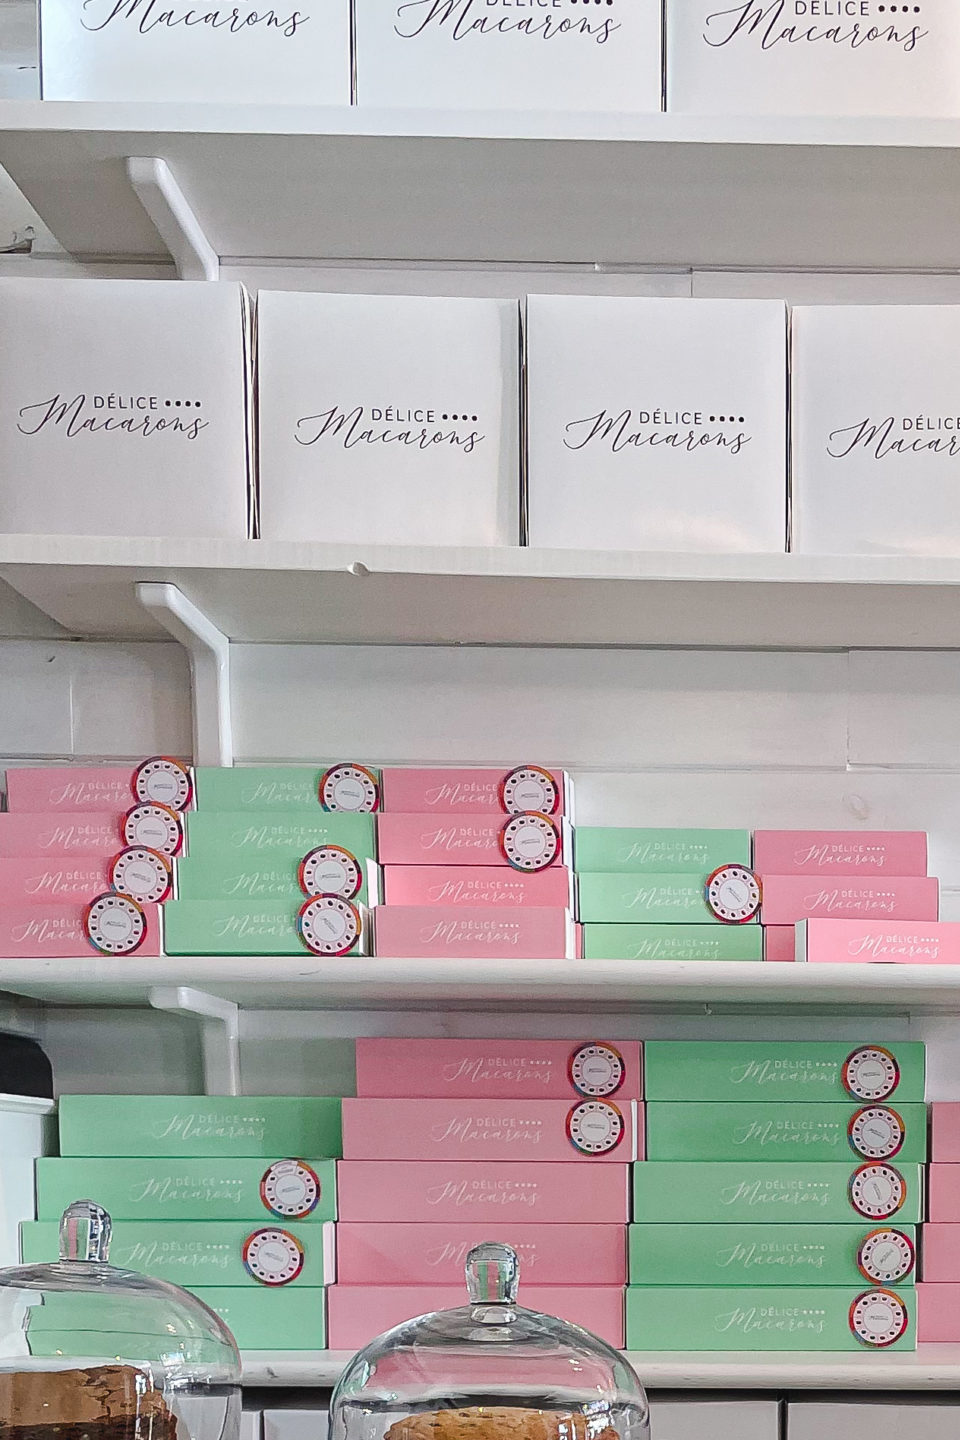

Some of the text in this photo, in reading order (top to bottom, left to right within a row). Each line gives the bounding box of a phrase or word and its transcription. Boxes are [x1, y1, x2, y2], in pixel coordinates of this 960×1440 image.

[80, 0, 310, 37] Macarons
[394, 0, 621, 44] Macarons
[703, 0, 928, 51] Macarons
[94, 393, 157, 409] DÉLICE
[17, 393, 209, 439] Macarons
[372, 405, 435, 422] DÉLICE
[640, 408, 702, 425] DÉLICE
[295, 405, 485, 453] Macarons
[563, 408, 752, 454] Macarons
[795, 844, 887, 866] Macarons
[832, 843, 864, 853] DÉLICE
[428, 880, 525, 903] Macarons
[468, 879, 502, 888] DÉLICE
[841, 890, 874, 898] DÉLICE
[804, 889, 897, 912] Macarons
[53, 917, 81, 927] DÉLIC
[420, 920, 520, 943] Macarons
[461, 919, 496, 928] DÉLICE
[848, 934, 940, 957] Macarons
[887, 934, 919, 943] DÉLICE
[730, 1060, 837, 1085] Macarons
[774, 1059, 813, 1070] DÉLICE
